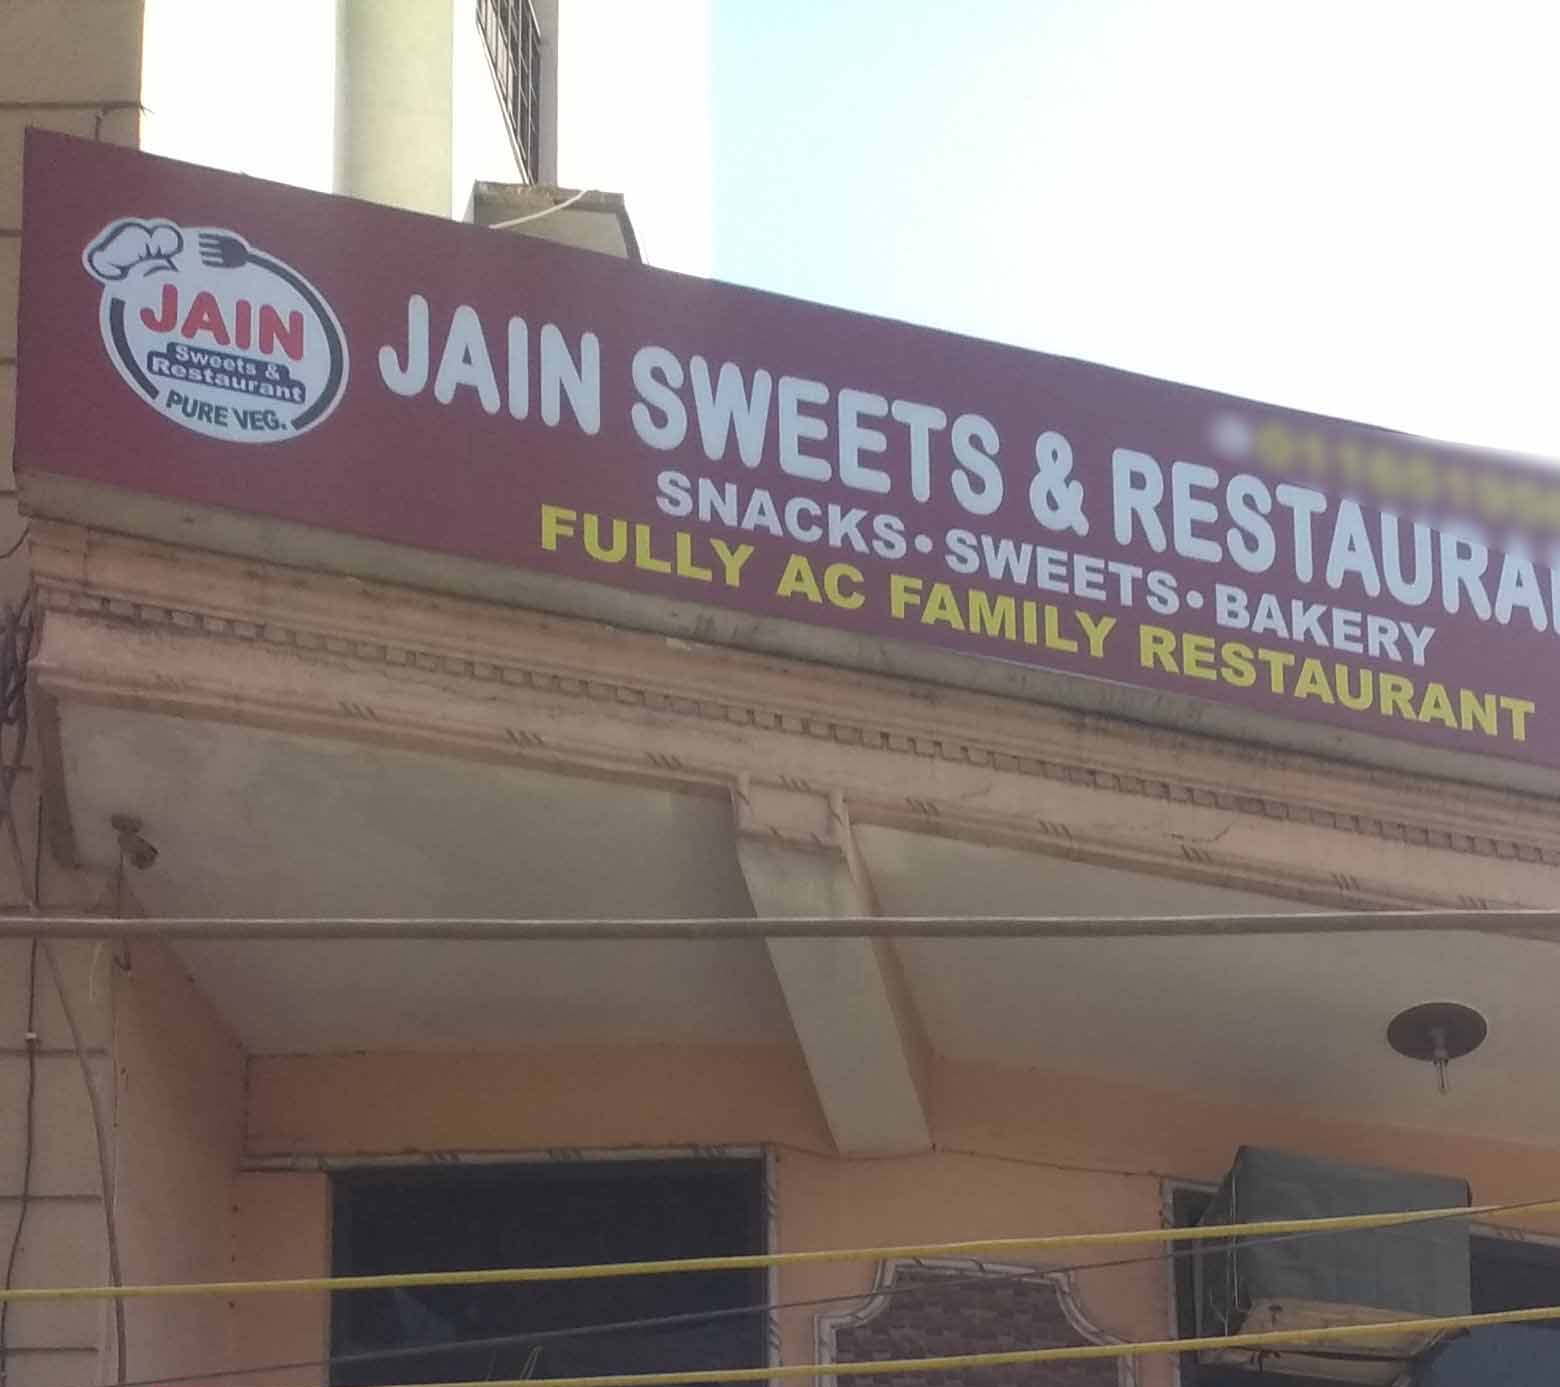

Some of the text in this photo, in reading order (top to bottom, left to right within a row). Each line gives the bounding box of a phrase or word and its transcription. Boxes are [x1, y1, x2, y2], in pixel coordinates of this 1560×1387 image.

[140, 283, 304, 362] JAIN
[152, 352, 303, 402] Restaurant
[175, 345, 282, 381] Sweets &
[166, 389, 288, 431] PURE VEG.
[379, 294, 601, 436] JAIN
[630, 345, 1003, 516] SWEETS
[1029, 430, 1088, 536] &
[656, 469, 1436, 667] SNACKS SWEETS BAKERY
[540, 504, 1536, 742] FULLY AC FAMILY RESTAURANT
